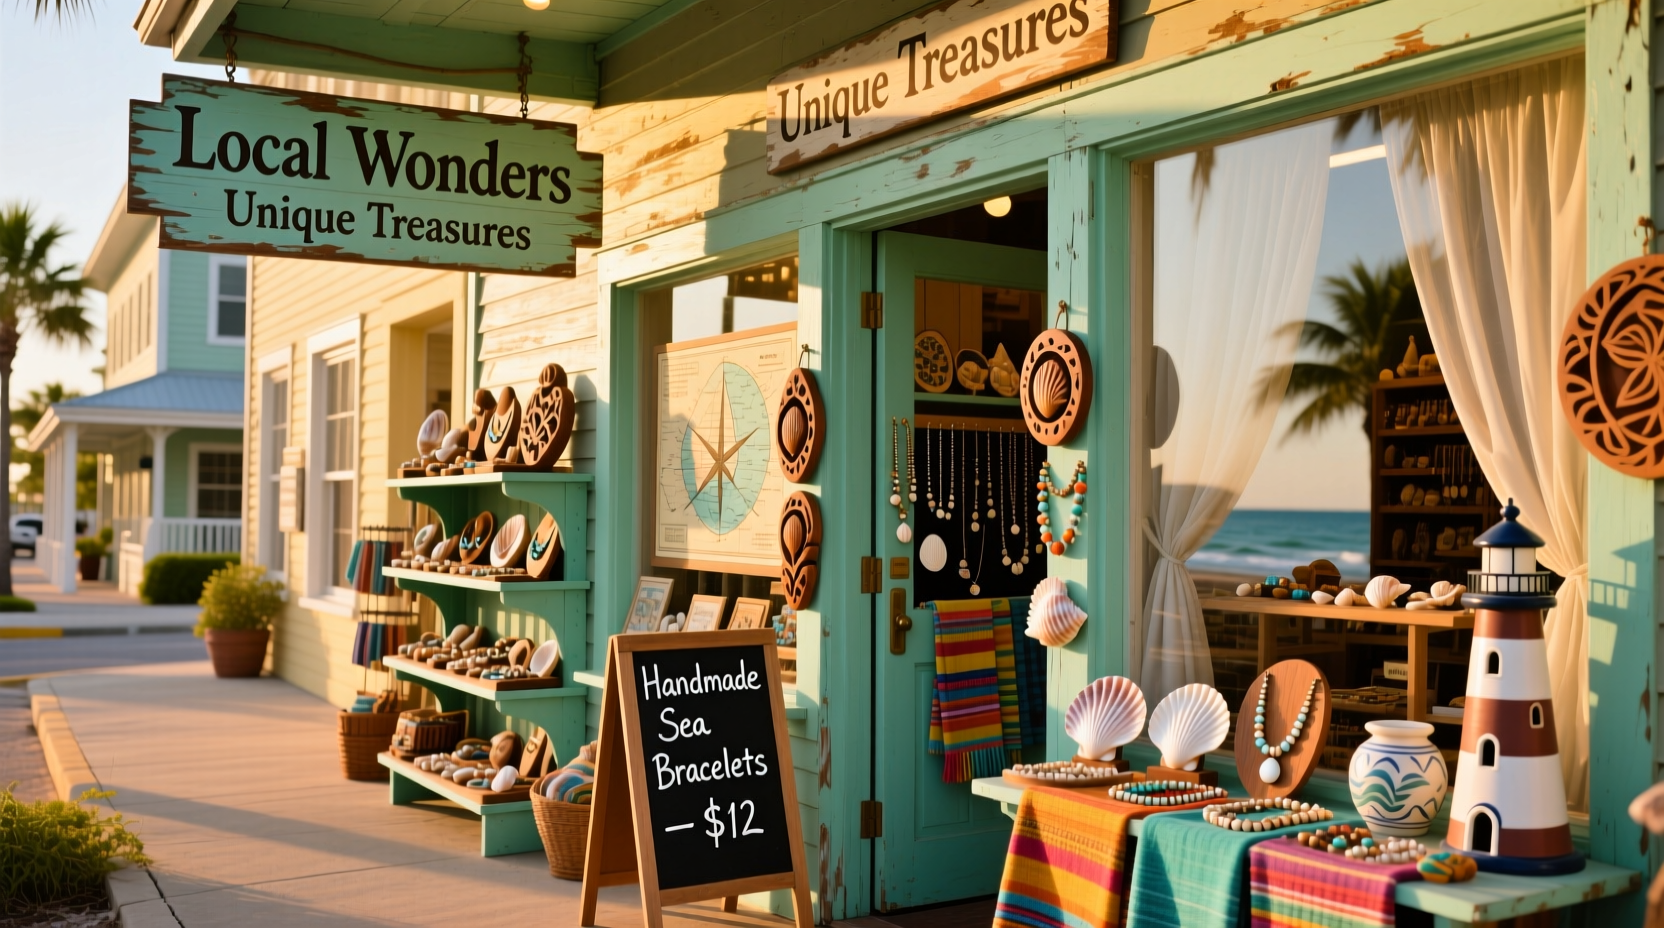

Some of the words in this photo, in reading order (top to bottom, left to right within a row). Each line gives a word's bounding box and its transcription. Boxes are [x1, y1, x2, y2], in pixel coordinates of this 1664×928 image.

[778, 71, 890, 143] Unique
[897, 0, 1090, 98] Treasures
[173, 105, 331, 180] Local
[346, 126, 572, 204] Wonders
[224, 189, 356, 243] Unique
[367, 202, 531, 250] Treasures
[642, 659, 762, 701] Handmade
[658, 707, 712, 742] Sea
[652, 747, 768, 790] Bracelets
[704, 797, 764, 848] $12
